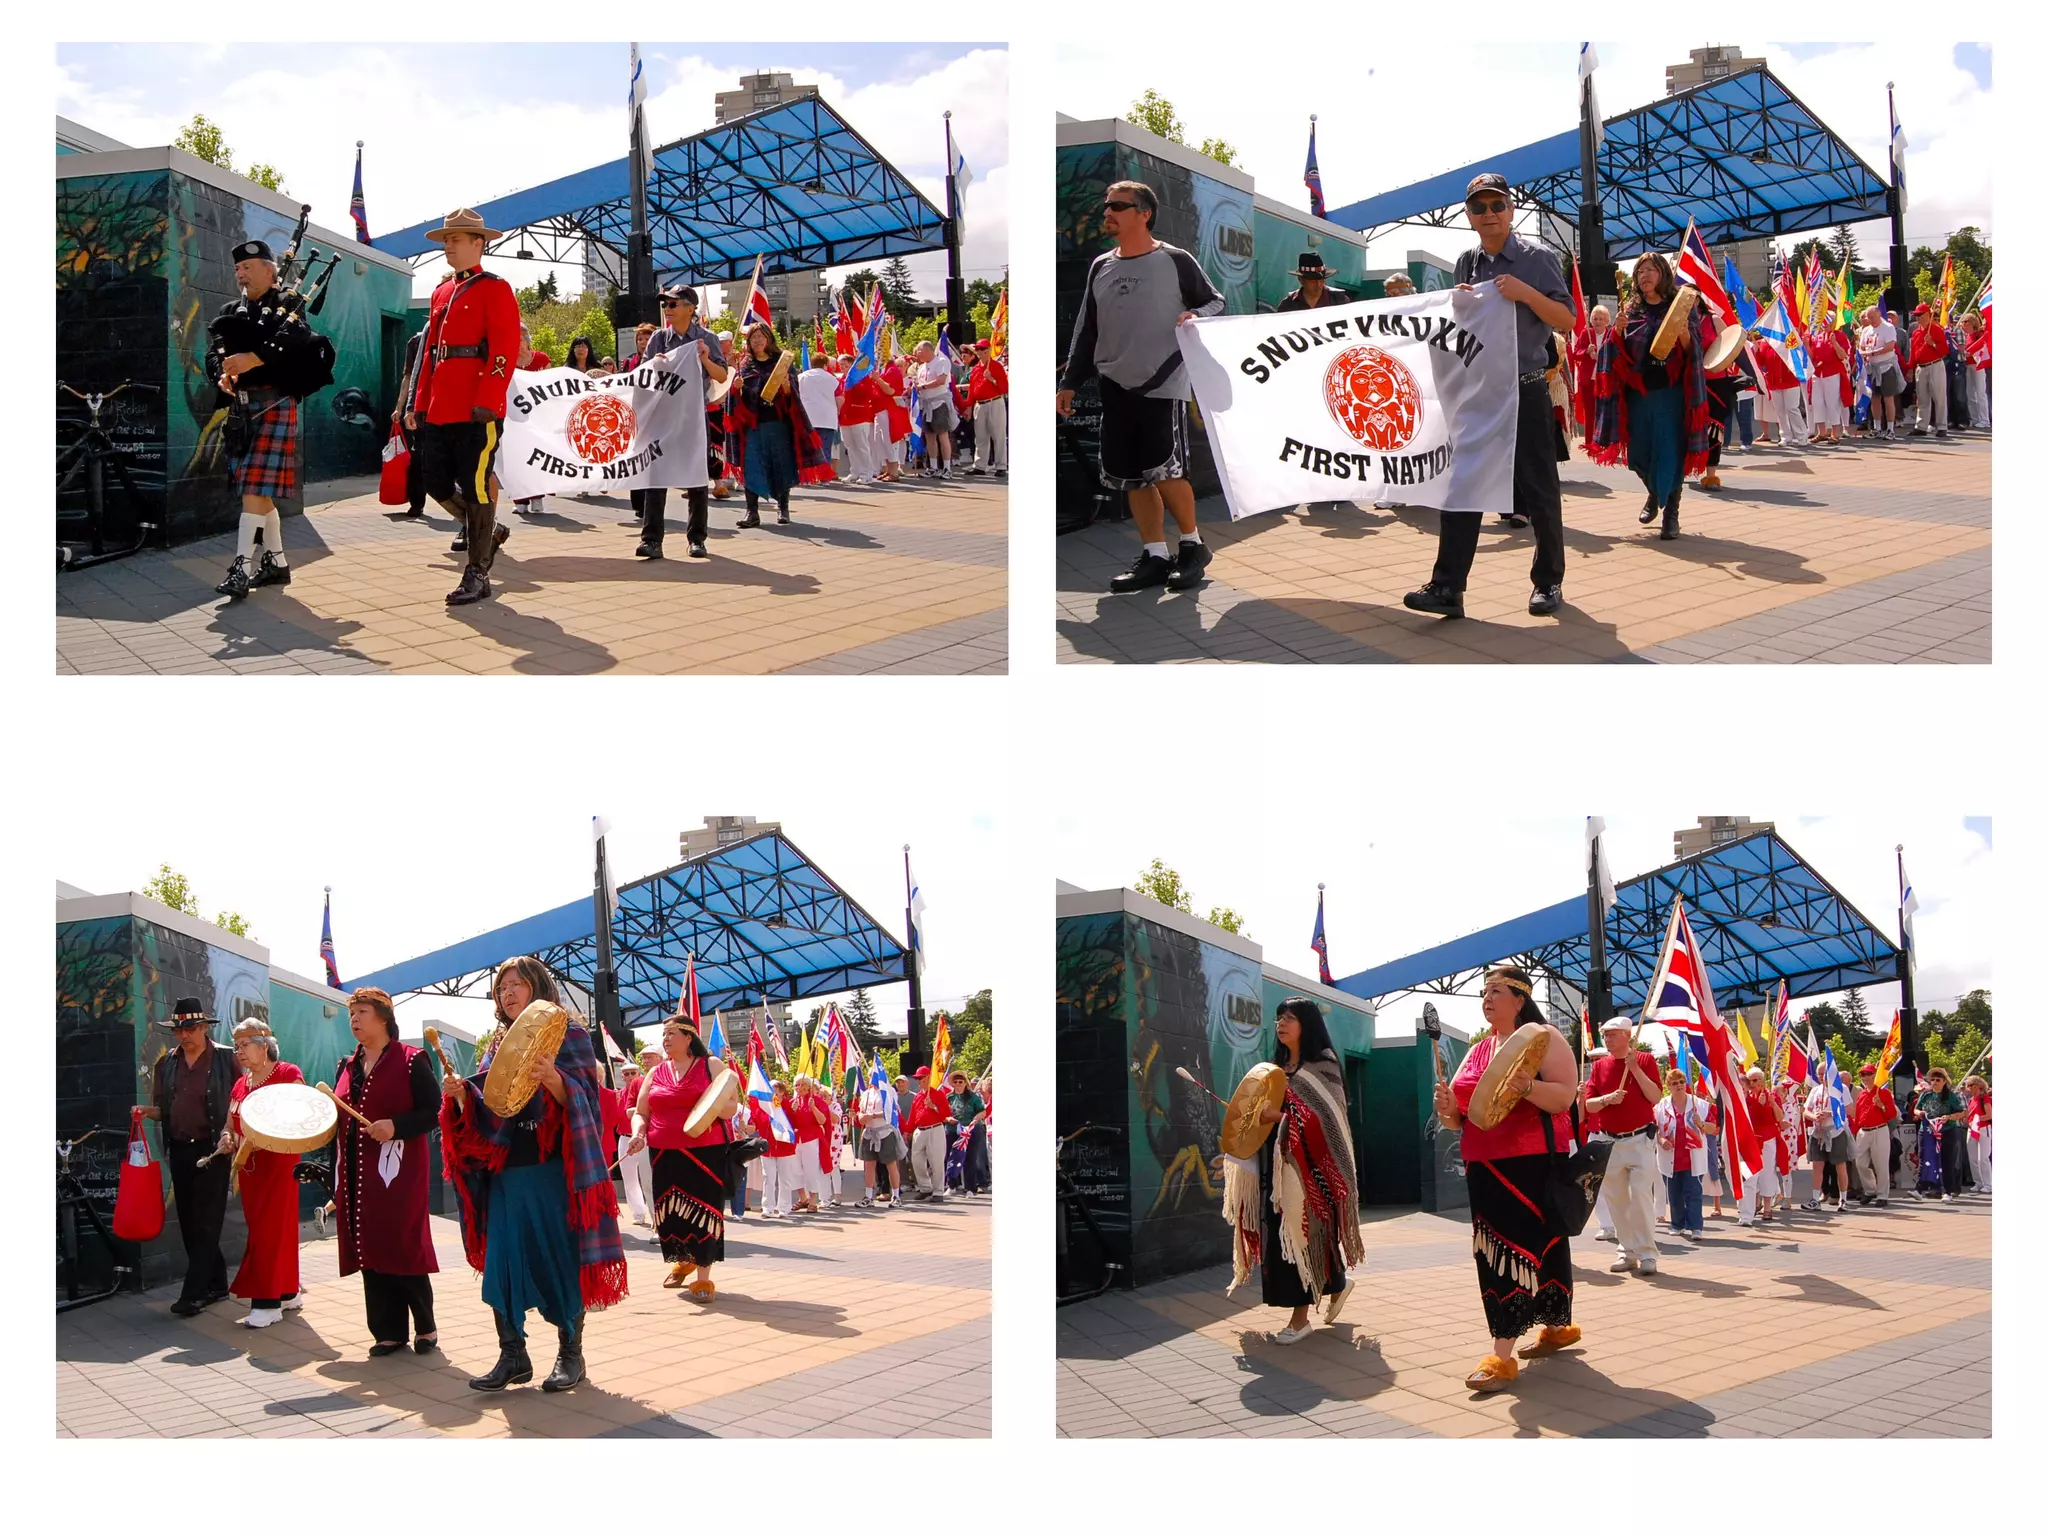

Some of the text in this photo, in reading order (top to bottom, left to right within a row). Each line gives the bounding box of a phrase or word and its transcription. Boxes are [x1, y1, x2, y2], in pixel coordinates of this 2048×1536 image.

[526, 439, 664, 479] FIRST NATION
[1279, 437, 1371, 482] FIRST
